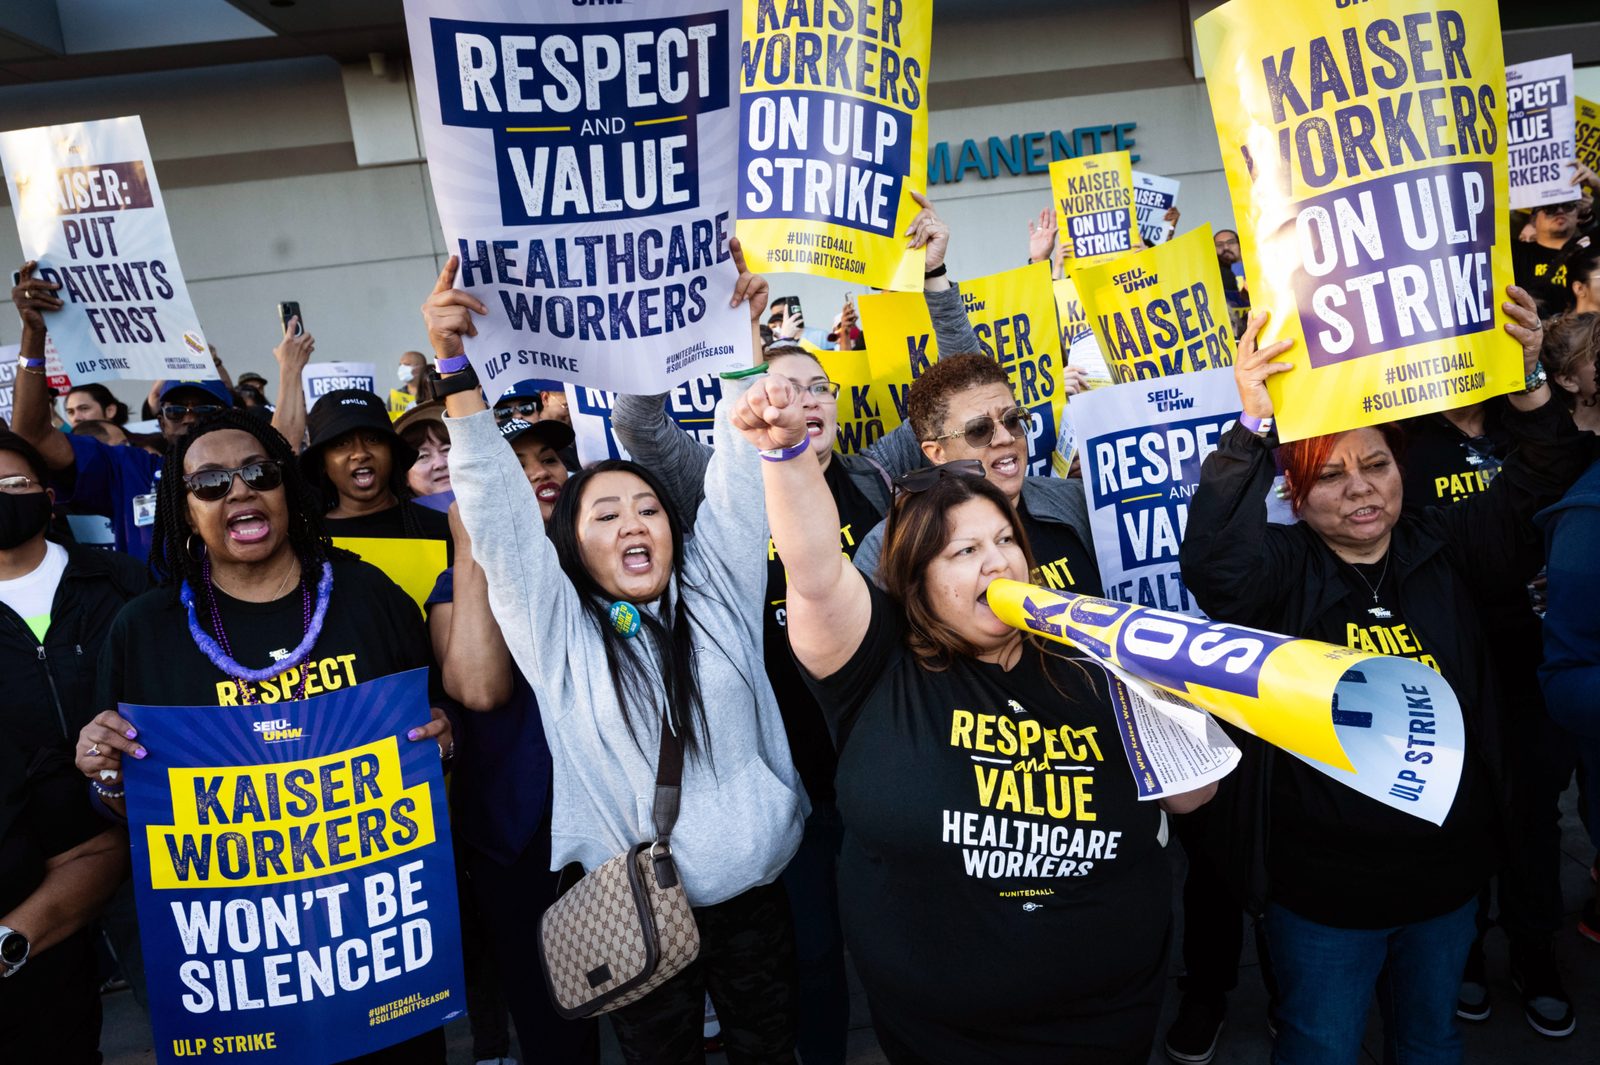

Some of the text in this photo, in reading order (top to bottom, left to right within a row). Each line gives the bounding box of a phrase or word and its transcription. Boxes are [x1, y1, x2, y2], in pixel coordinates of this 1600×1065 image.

[455, 23, 716, 112] RESPECT
[1262, 10, 1472, 123] KAISER
[1507, 79, 1560, 113] PECT
[580, 117, 626, 136] AND
[749, 97, 897, 164] ON ULP
[57, 168, 131, 210] AISER:
[508, 134, 690, 216] VALUE
[746, 158, 893, 229] STRIKE
[1068, 170, 1120, 195] KAISER
[1061, 188, 1131, 216] WORKERS
[63, 216, 118, 260] PUT
[1073, 215, 1094, 236] ON
[1097, 210, 1125, 233] ULP
[1296, 171, 1485, 277] ON ULP
[458, 211, 730, 289] HEALTHCARE
[767, 249, 866, 274] #SOLIDARITYSEASON
[787, 232, 853, 254] #UNITED4ALL
[1076, 231, 1129, 256] STRIKE
[39, 260, 174, 304] PATIENTS
[1112, 268, 1146, 286] SEIU-
[1123, 274, 1158, 294] UHW
[499, 276, 707, 341] WORKERS
[1098, 282, 1214, 361] KAISER
[1312, 252, 1492, 354] STRIKE
[86, 306, 166, 344] FIRST
[76, 358, 131, 373] ULP STRIKE
[485, 350, 579, 381] ULP STRIKE
[666, 341, 706, 364] #UNITED4ALL
[666, 345, 734, 374] #SOLIDARITYSEASON
[1385, 351, 1474, 384] #UNITED4ALL
[51, 376, 65, 384] NO
[1147, 388, 1183, 403] SEIU-
[1363, 371, 1486, 413] #SOLIDARITYSEASON
[1157, 398, 1194, 412] UHW
[1095, 419, 1236, 495] RESPE
[216, 654, 357, 706] RESPECT
[253, 719, 291, 732] SEIU-
[263, 728, 303, 741] UHW
[950, 710, 1104, 761] RESPECT
[1116, 682, 1146, 771] Why Kaiser Workers
[1388, 683, 1436, 802] ULP STRIKE
[1014, 753, 1051, 772] and
[193, 753, 383, 825] KAISER
[975, 764, 1096, 821] VALUE
[164, 797, 419, 882] WORKERS
[942, 810, 1122, 859] HEALTHCARE
[963, 848, 1094, 878] WORKERS
[170, 860, 429, 954] WON'T BE
[999, 888, 1054, 897] #UNITED4ALL
[180, 918, 433, 1014] SILENCED
[369, 992, 422, 1017] #UNITED4ALL
[370, 989, 450, 1026] #SOLIDARITYSEASON
[173, 1032, 277, 1057] ULP STRIKE
